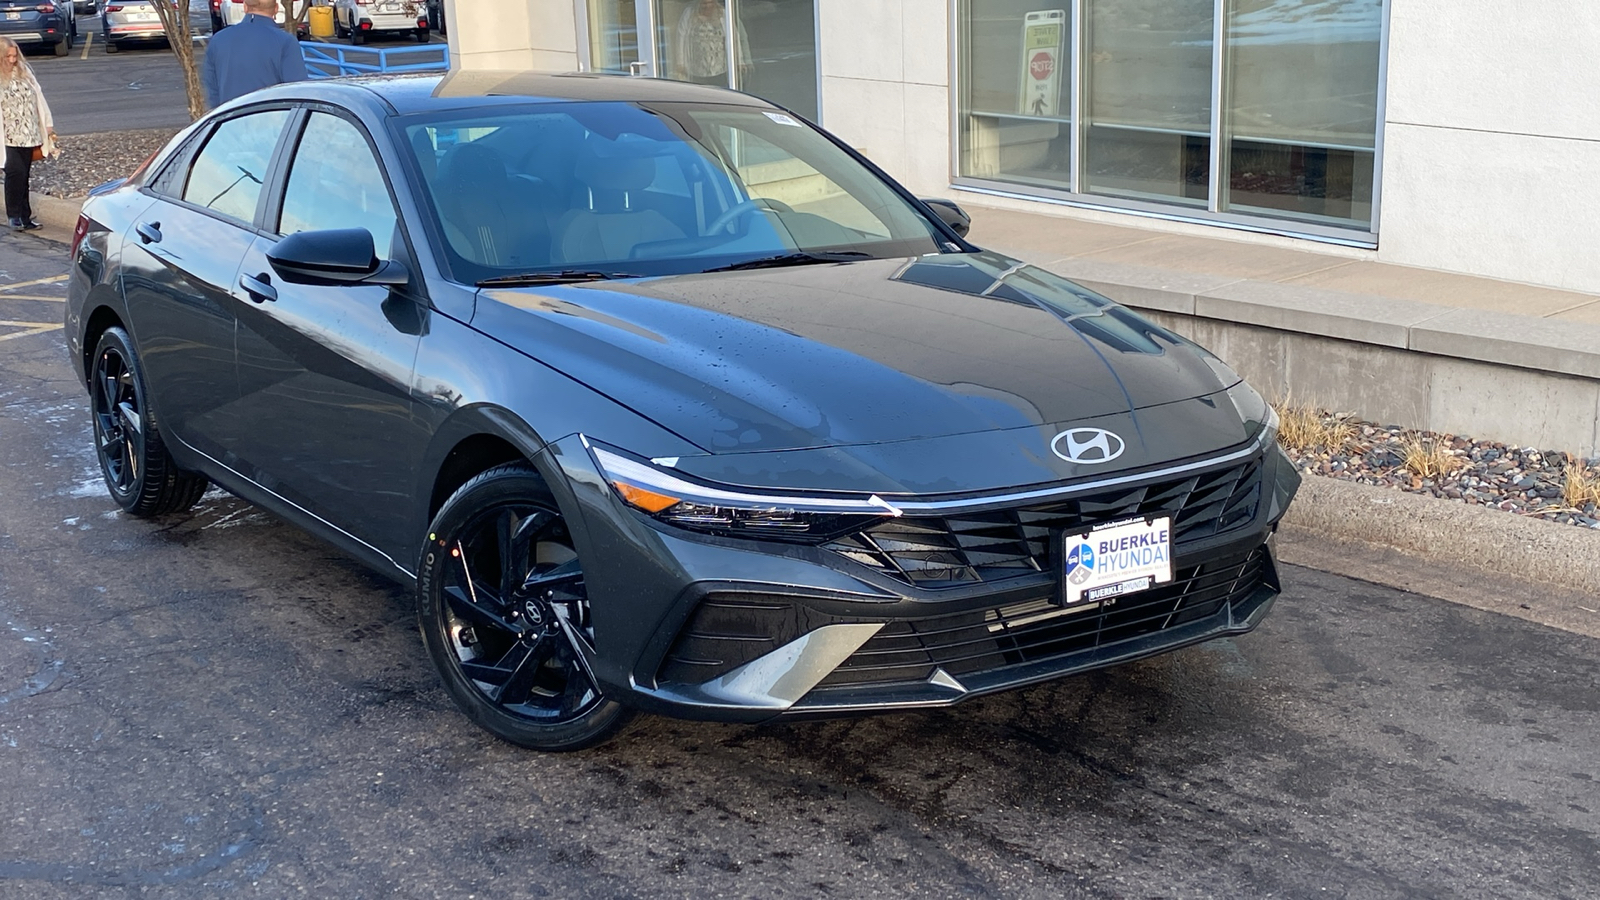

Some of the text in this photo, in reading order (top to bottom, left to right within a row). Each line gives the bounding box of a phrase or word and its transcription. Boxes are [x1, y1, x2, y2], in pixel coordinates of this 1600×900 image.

[1099, 530, 1167, 554] BUERKLE
[1098, 545, 1168, 573] HYUNDAI
[422, 552, 434, 616] KUMHO
